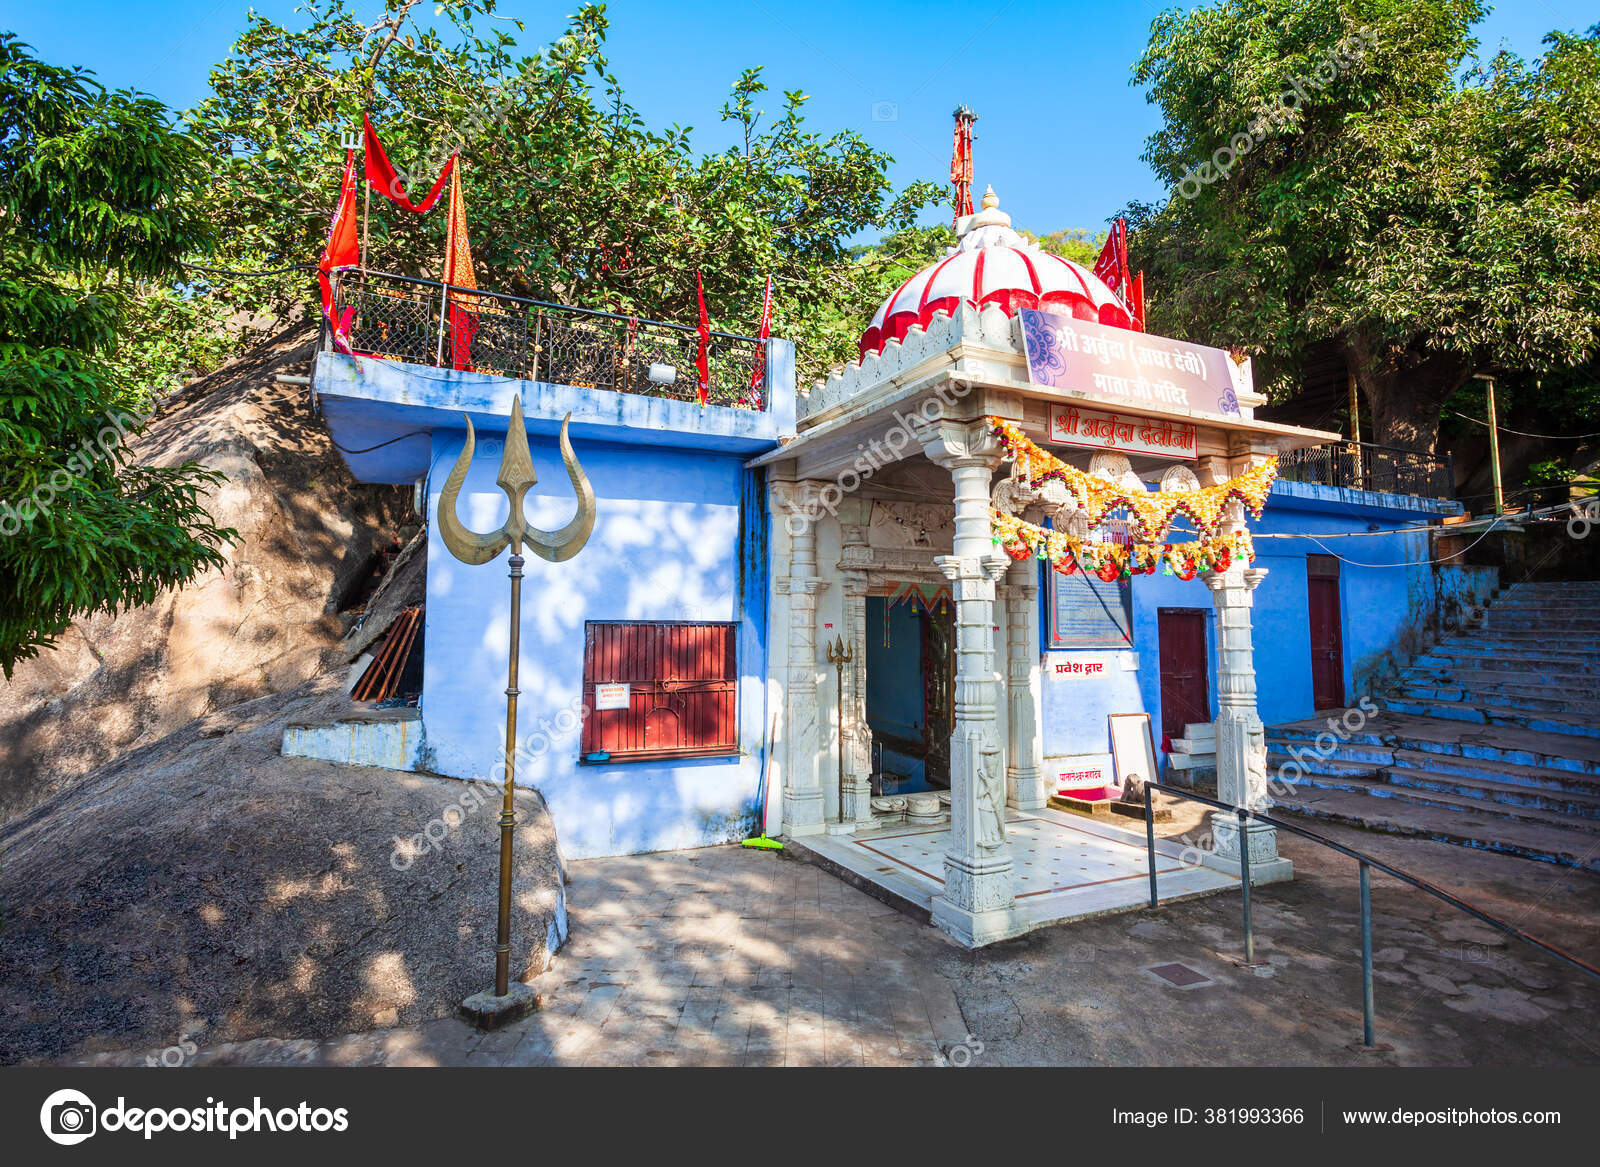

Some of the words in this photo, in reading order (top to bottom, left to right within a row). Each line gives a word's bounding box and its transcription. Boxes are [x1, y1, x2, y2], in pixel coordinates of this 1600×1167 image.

[1056, 326, 1078, 352] श्री
[1092, 373, 1129, 397] माता
[1130, 376, 1151, 400] जी
[1152, 379, 1189, 406] मंदिर
[1056, 407, 1080, 434] श्री
[1082, 415, 1136, 446] अर्बुदा
[1055, 661, 1083, 674] प्रवेश
